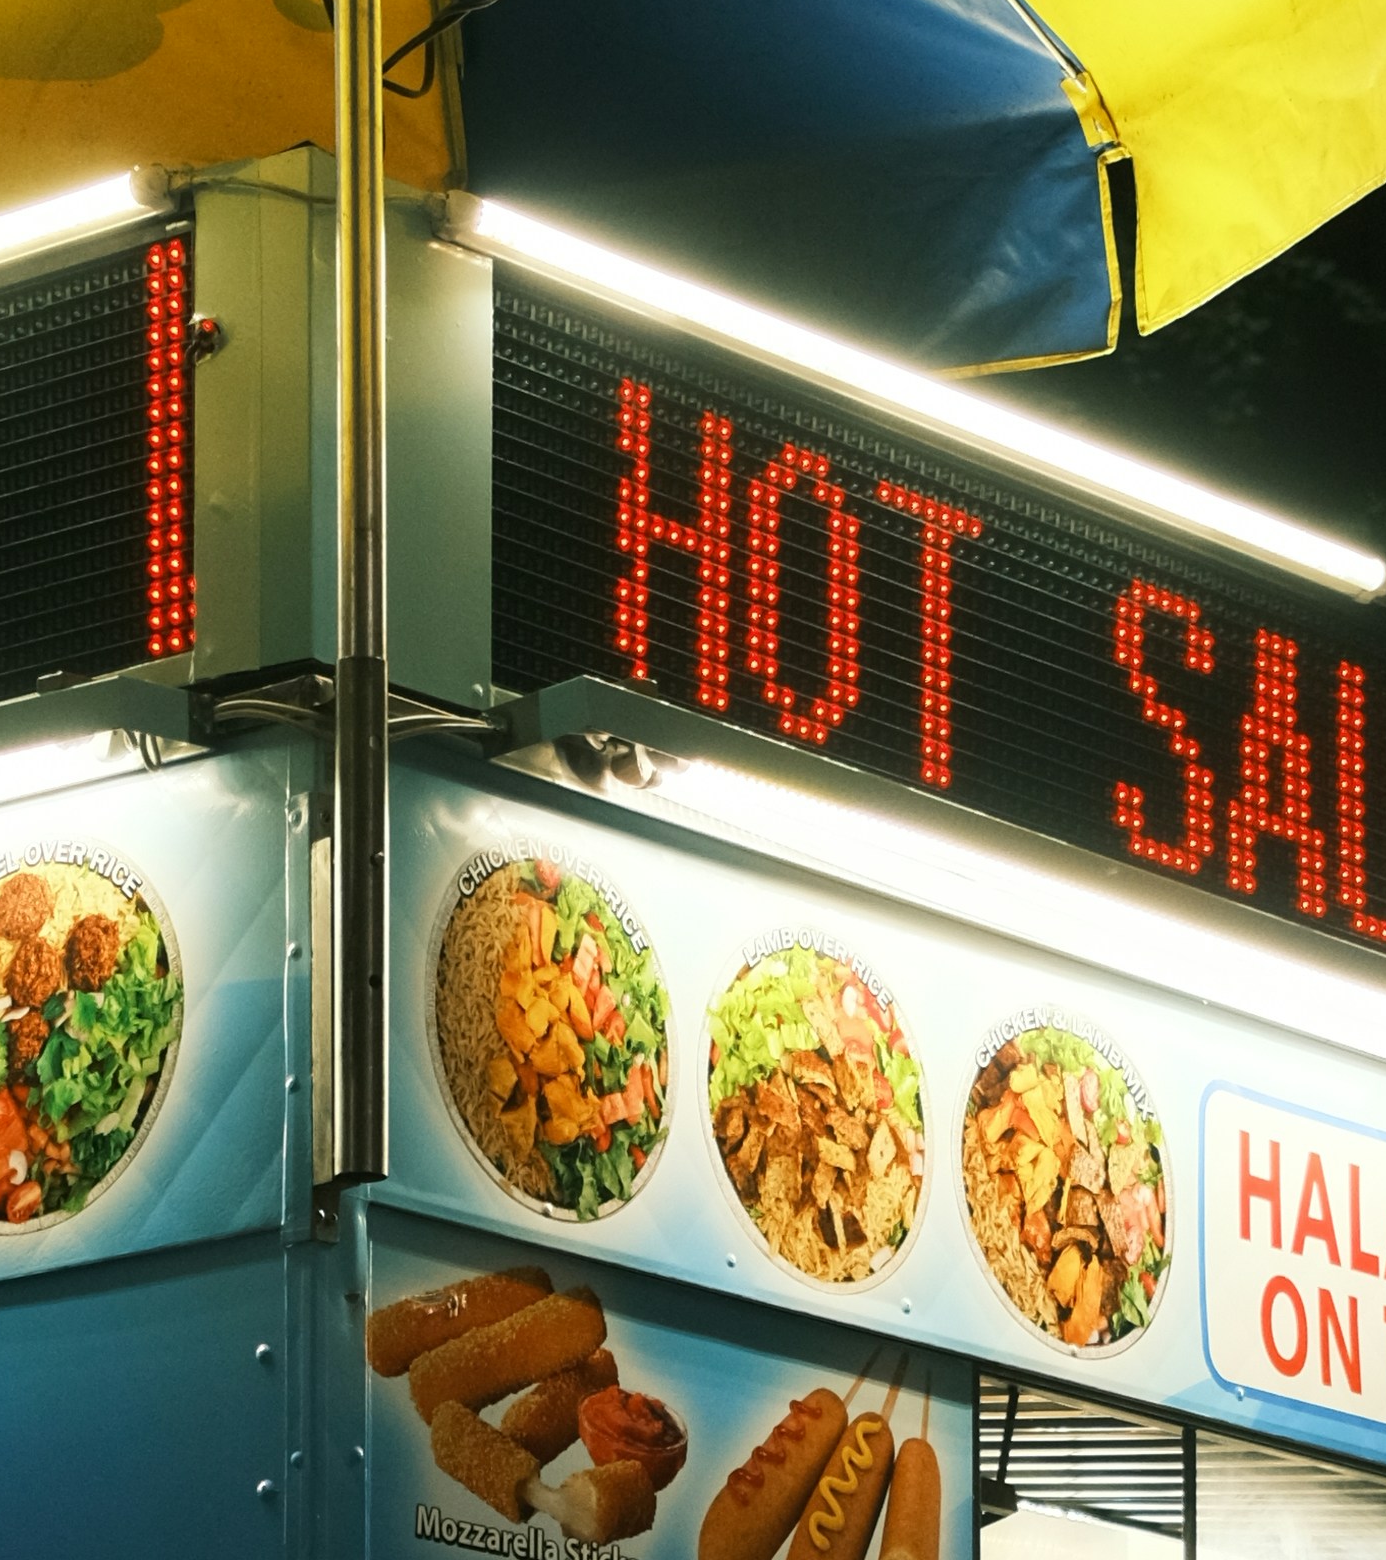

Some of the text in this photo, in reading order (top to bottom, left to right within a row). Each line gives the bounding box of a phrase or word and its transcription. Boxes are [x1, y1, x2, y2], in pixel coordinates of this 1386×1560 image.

[616, 377, 983, 792] HOT
[24, 840, 88, 866] OVER
[89, 847, 142, 899] RICE
[458, 838, 650, 956] CHICKEN OVER RICE
[742, 927, 894, 1013] LAMB OVER RICE
[975, 1007, 1155, 1123] CHICKEN & LAMB MIX
[1260, 1274, 1361, 1396] ON
